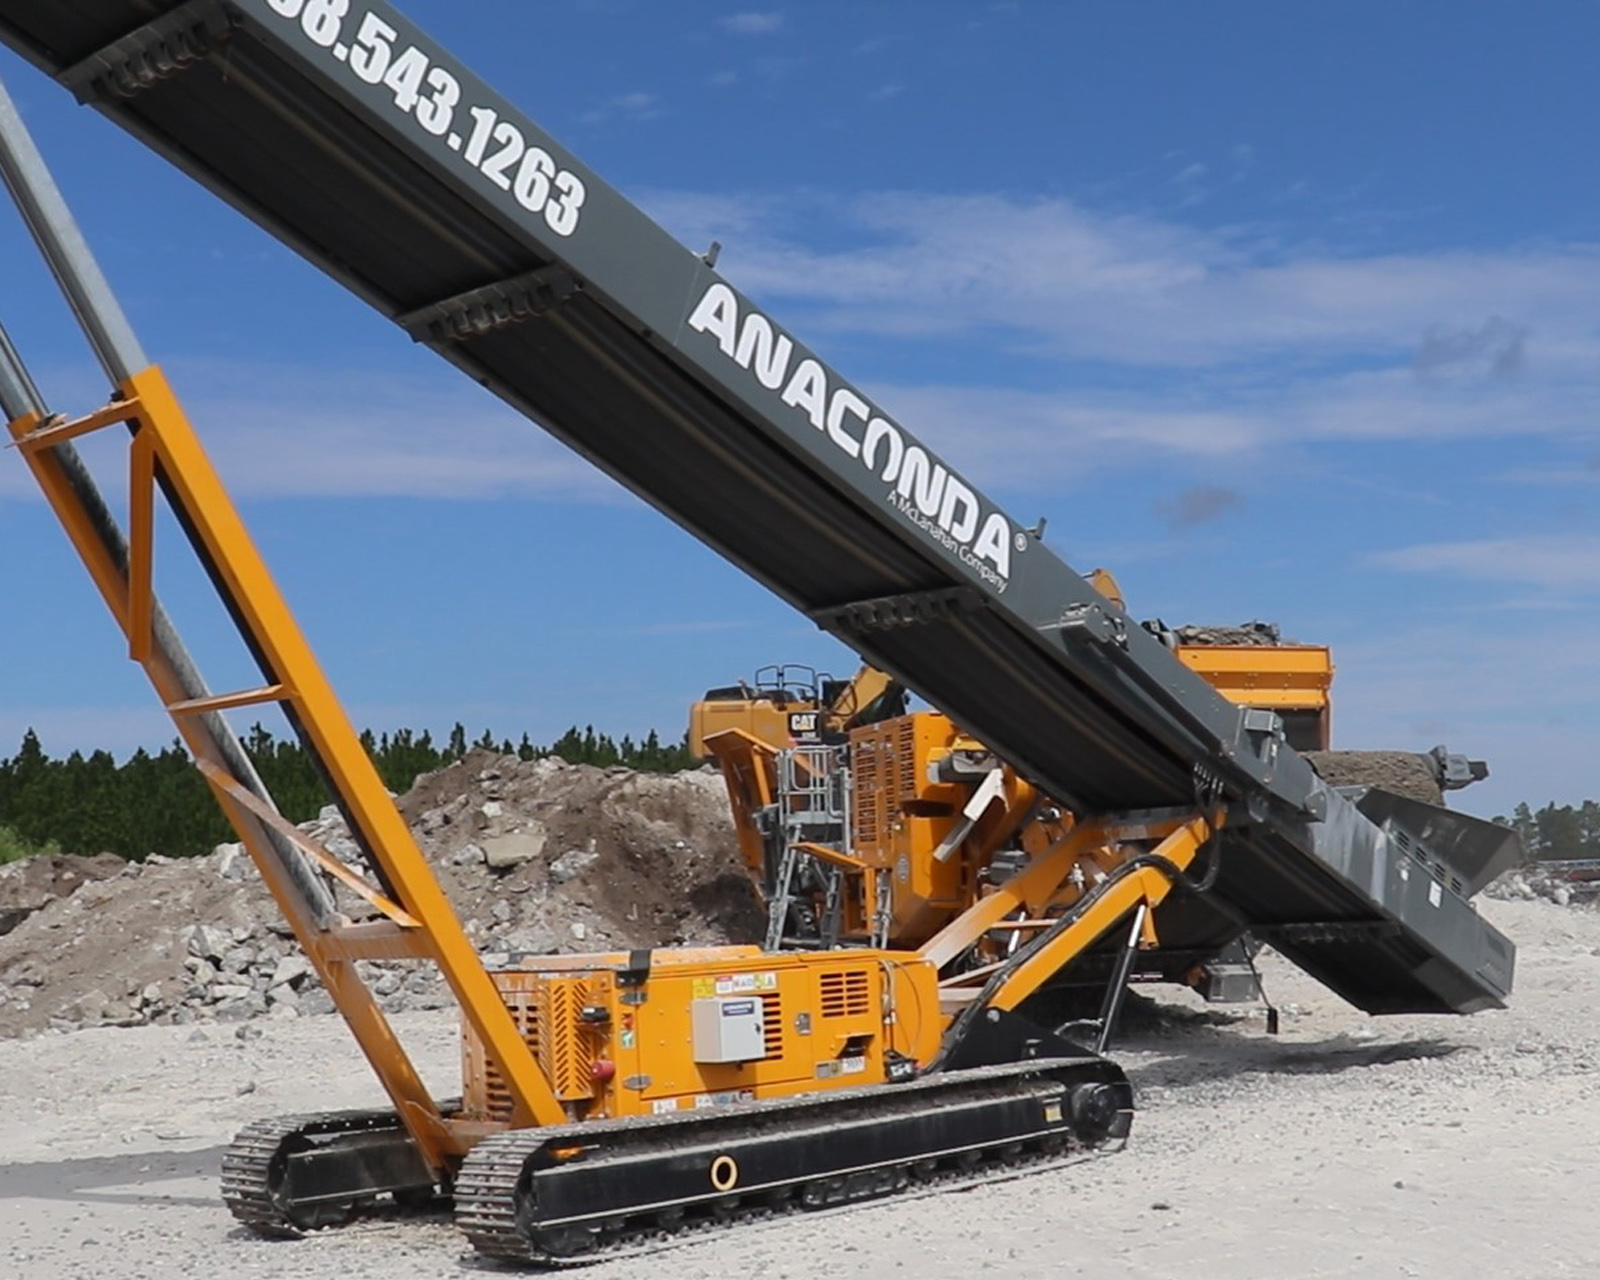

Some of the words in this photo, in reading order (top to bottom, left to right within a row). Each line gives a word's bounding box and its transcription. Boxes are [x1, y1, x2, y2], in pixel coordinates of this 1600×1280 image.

[266, 0, 586, 237] 8.543.1263
[688, 283, 1010, 579] ANACONDA
[887, 490, 897, 506] A
[897, 497, 959, 554] McLanahan
[959, 545, 1008, 594] Company
[791, 714, 817, 730] CAT
